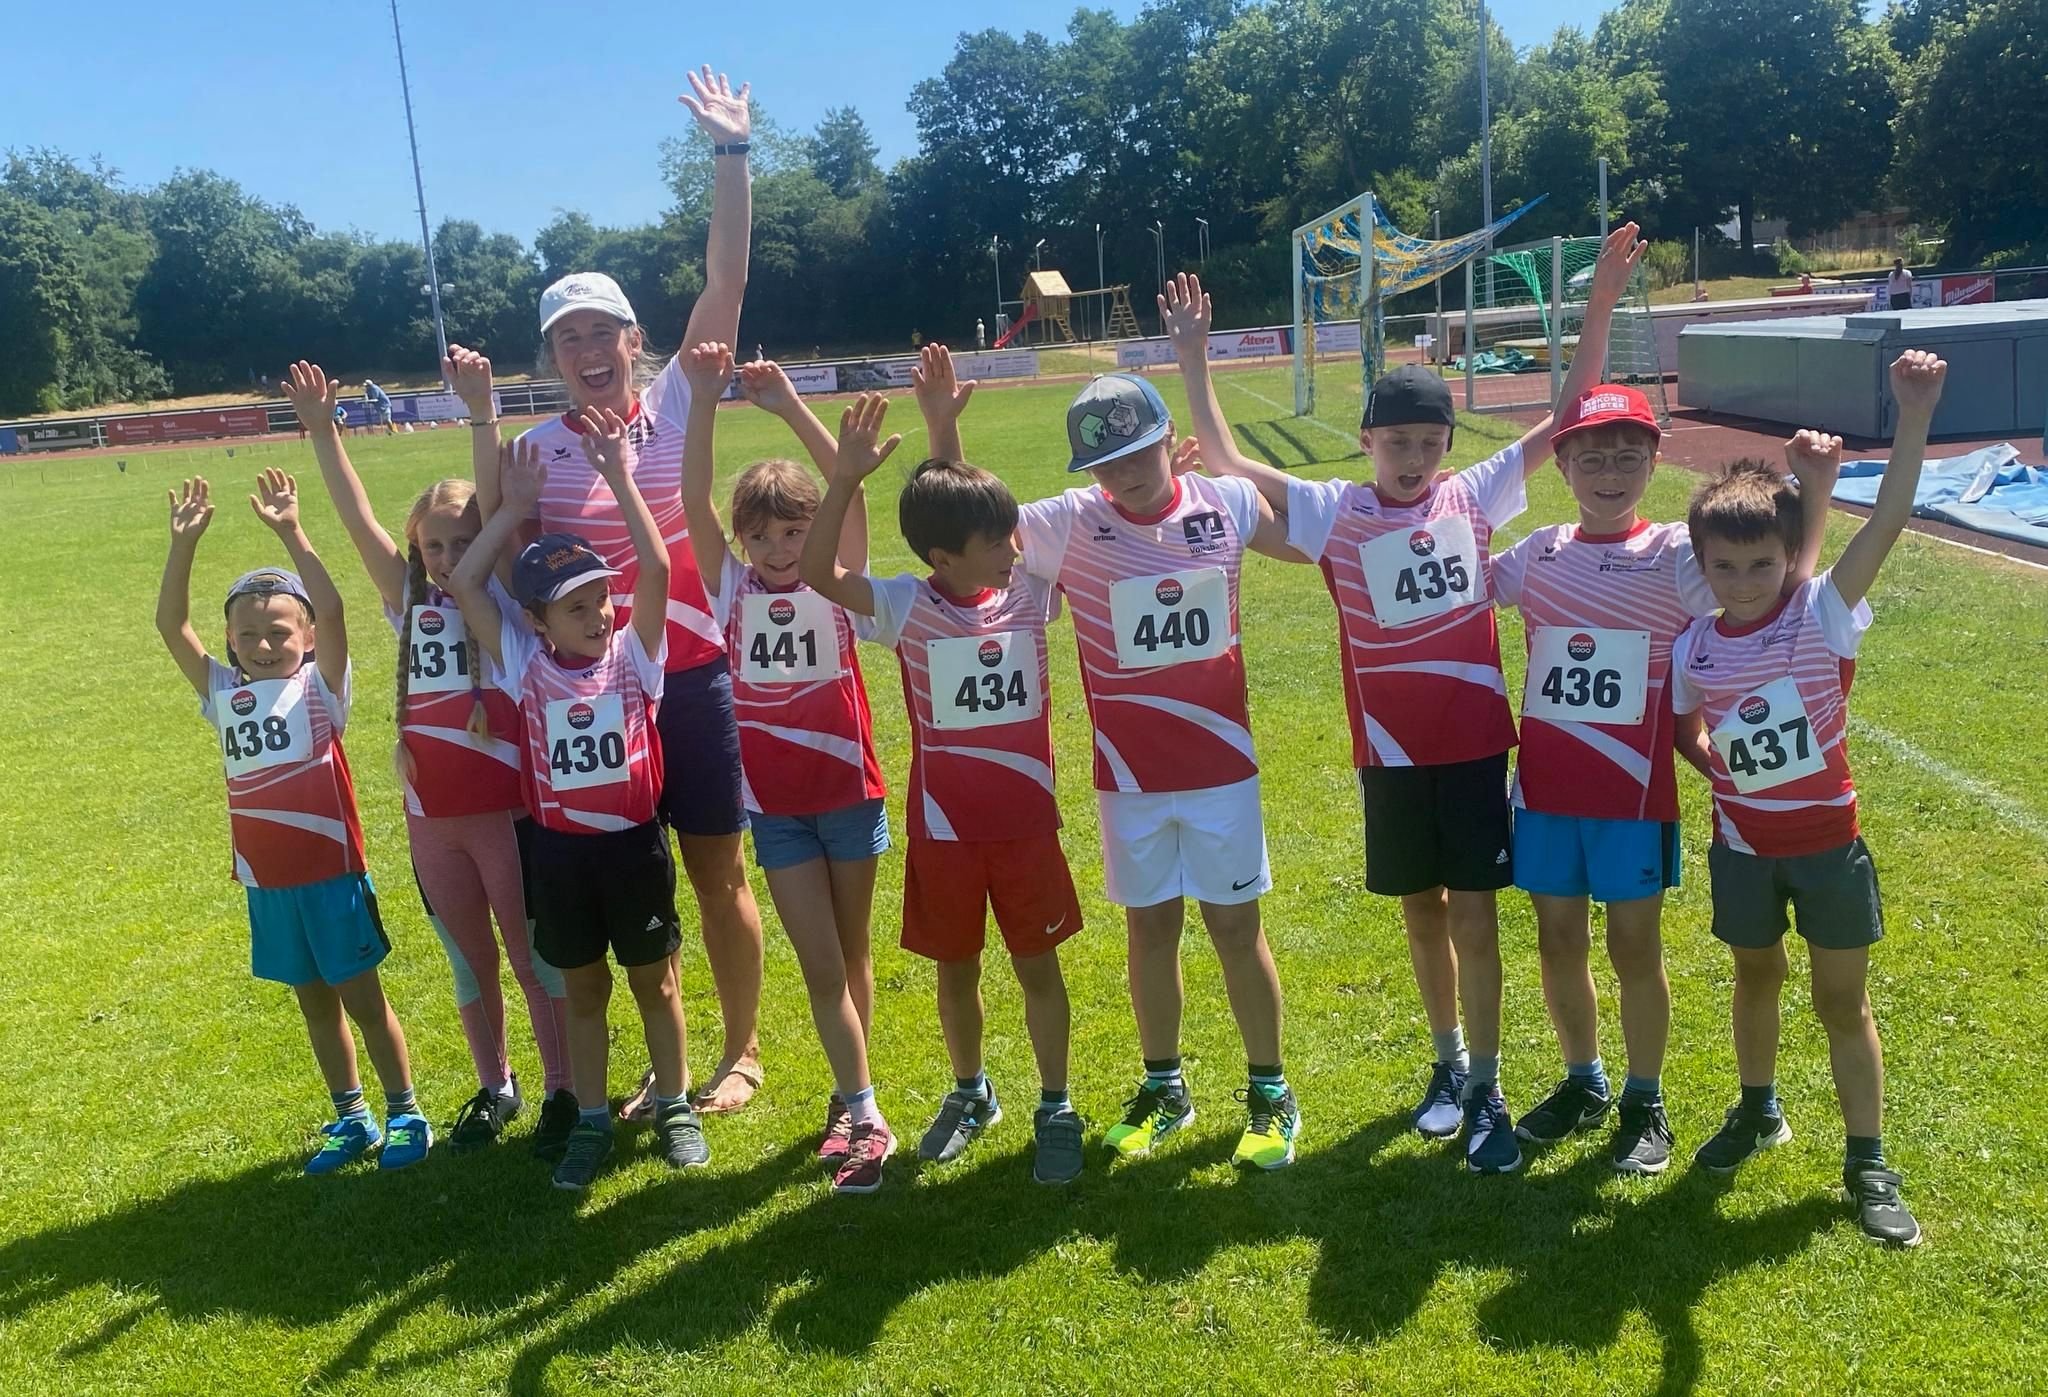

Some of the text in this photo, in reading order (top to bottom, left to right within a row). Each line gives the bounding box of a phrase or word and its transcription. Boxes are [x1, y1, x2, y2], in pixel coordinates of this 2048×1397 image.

[1239, 334, 1275, 346] Atera
[1395, 555, 1469, 604] 435
[750, 629, 816, 668] 441
[1133, 608, 1210, 652] 440
[410, 641, 468, 679] 431
[232, 696, 254, 704] SPORT
[235, 702, 253, 710] 2000
[955, 670, 1028, 712] 434
[1541, 666, 1621, 708] 436
[569, 710, 592, 718] SPORT
[1740, 701, 1765, 714] SPORT
[1744, 708, 1766, 719] 2000
[225, 715, 291, 761] 438
[551, 731, 626, 775] 430
[1729, 715, 1810, 776] 437
